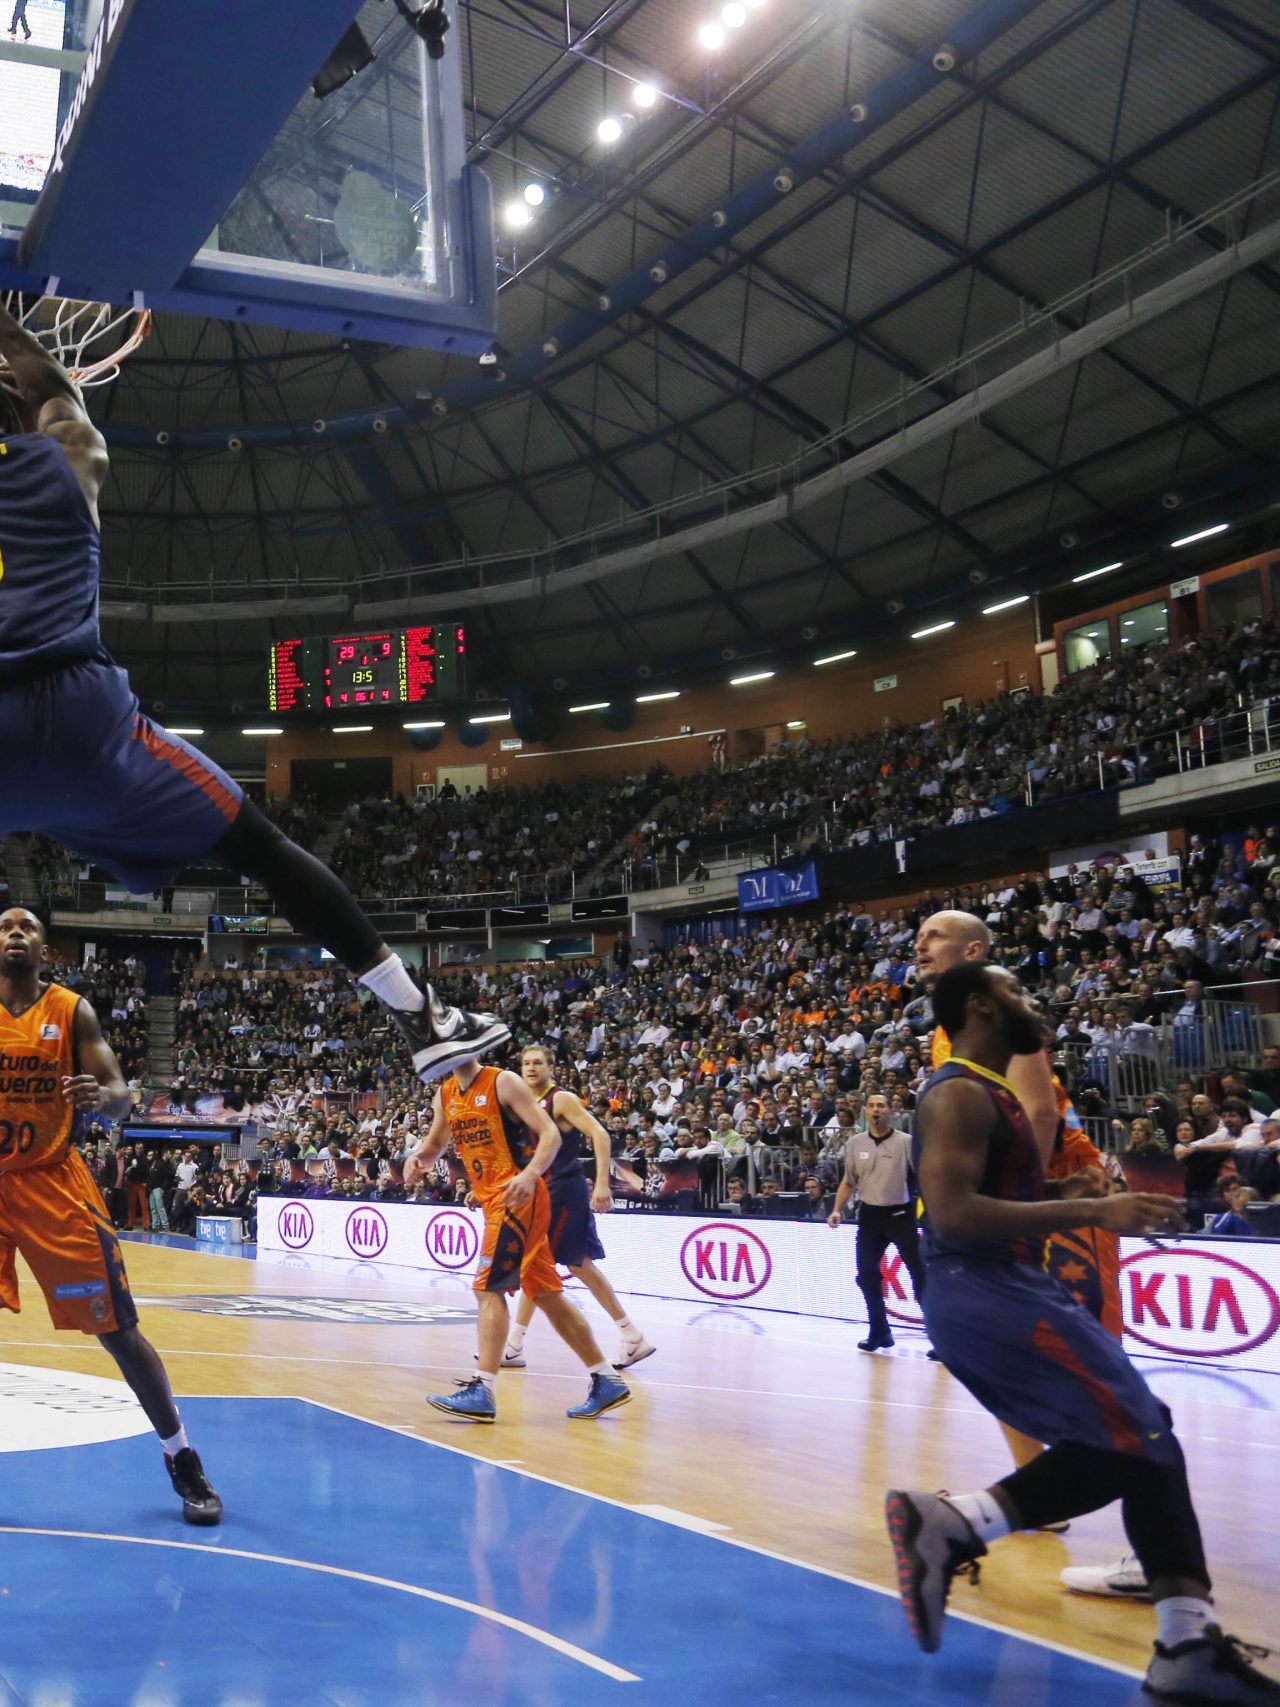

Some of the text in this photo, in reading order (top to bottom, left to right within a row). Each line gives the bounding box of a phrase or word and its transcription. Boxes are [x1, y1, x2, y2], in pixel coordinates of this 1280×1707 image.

[340, 643, 390, 659] 29 9
[352, 670, 373, 683] 13:5
[340, 693, 349, 703] 4
[382, 690, 390, 700] 4
[744, 876, 767, 899] M
[40, 1061, 58, 1071] del
[472, 1159, 483, 1180] 9
[200, 1222, 226, 1240] tve tve
[284, 1212, 756, 1284] KIA KIA KIA KIA
[1128, 1271, 1249, 1336] KIA
